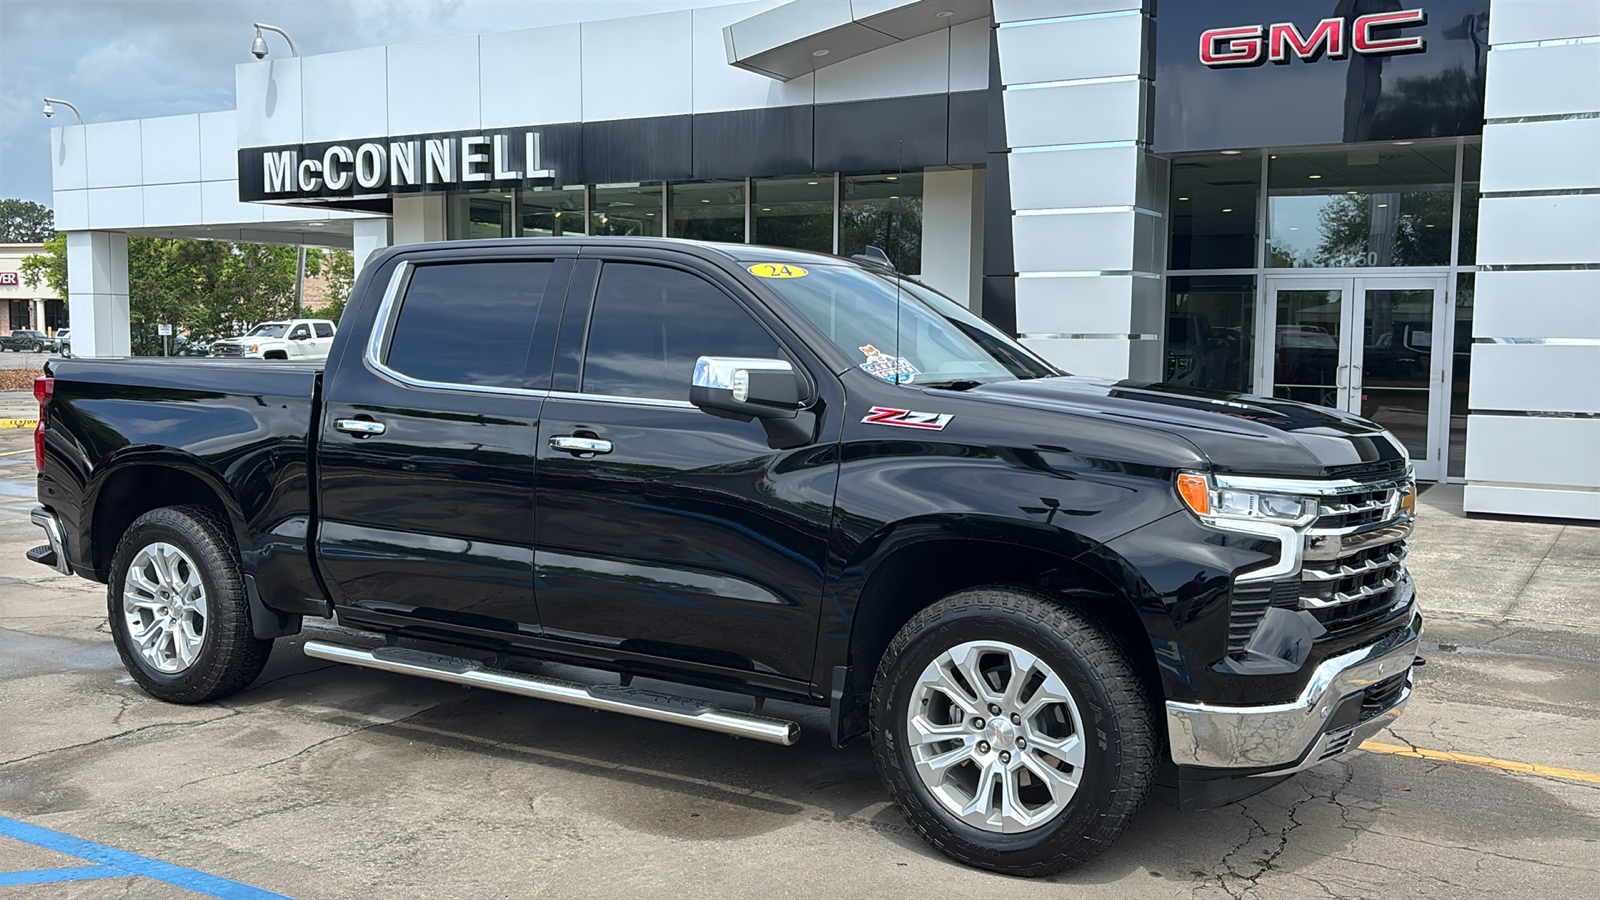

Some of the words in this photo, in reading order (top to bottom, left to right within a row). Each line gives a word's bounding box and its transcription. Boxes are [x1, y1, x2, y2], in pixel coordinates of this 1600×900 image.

[1199, 8, 1425, 66] GMC
[263, 131, 555, 194] McCONNELL
[767, 264, 793, 277] 24
[861, 405, 955, 431] Z71
